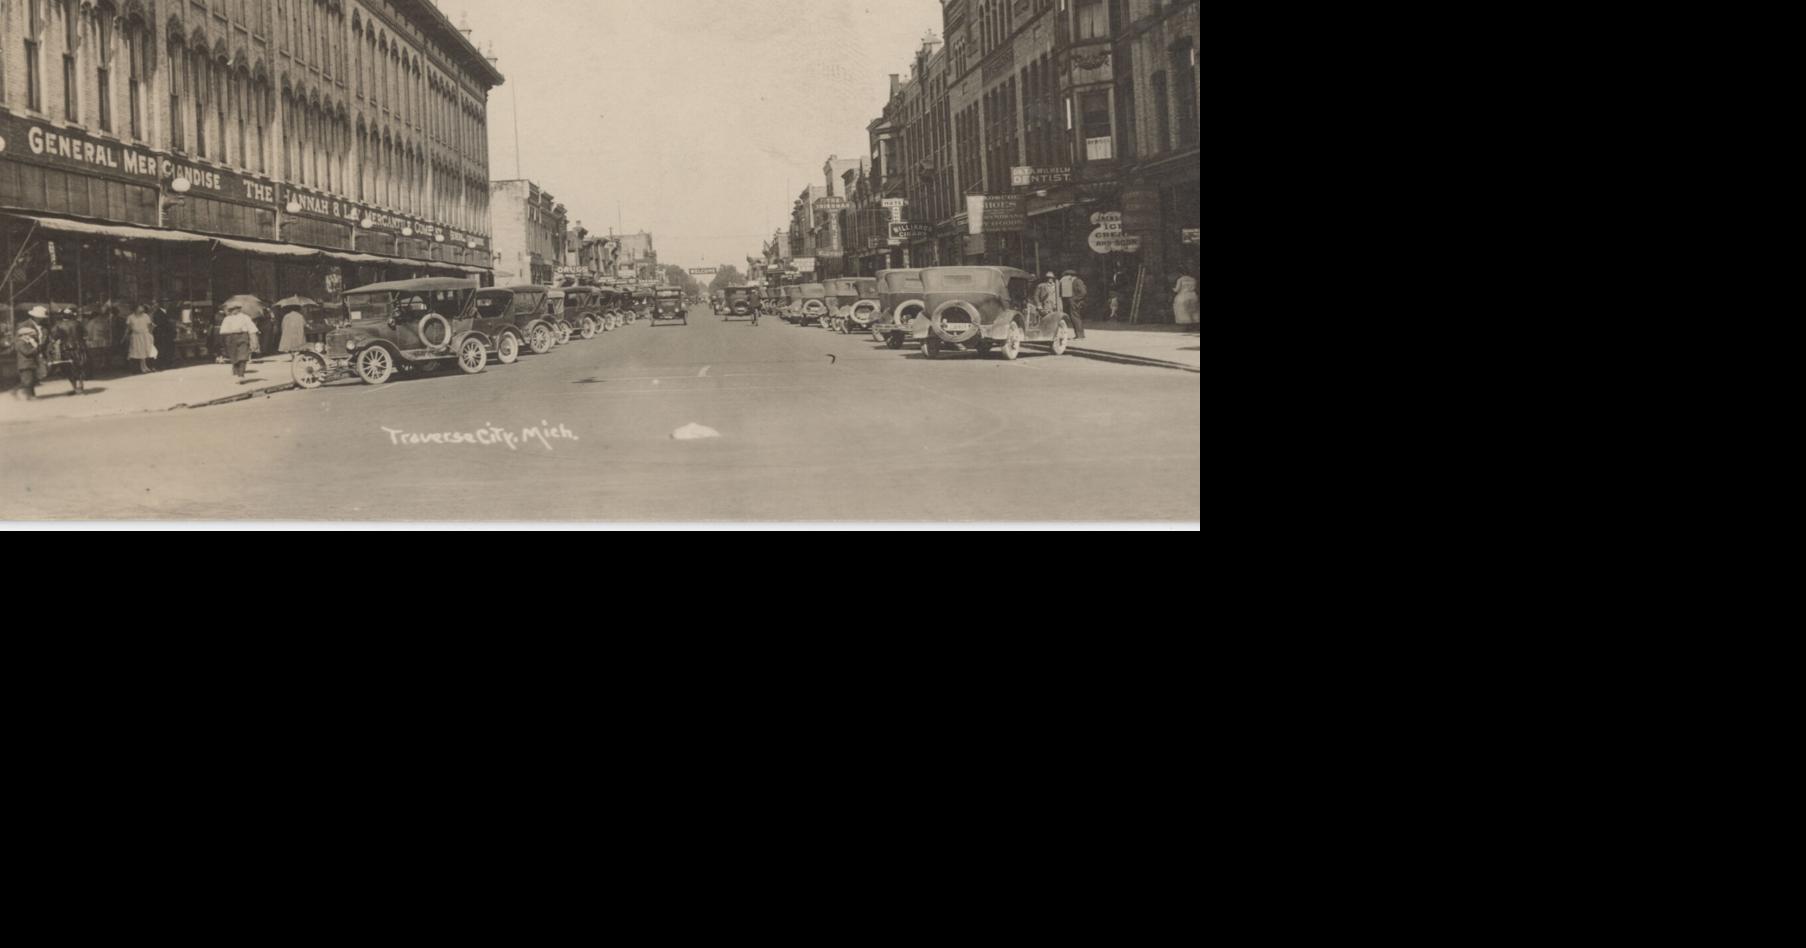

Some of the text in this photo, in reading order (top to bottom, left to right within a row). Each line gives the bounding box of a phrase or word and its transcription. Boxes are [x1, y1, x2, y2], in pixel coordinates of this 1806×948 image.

[28, 126, 117, 169] GENERAL
[243, 179, 273, 203] THE
[333, 202, 341, 217] &
